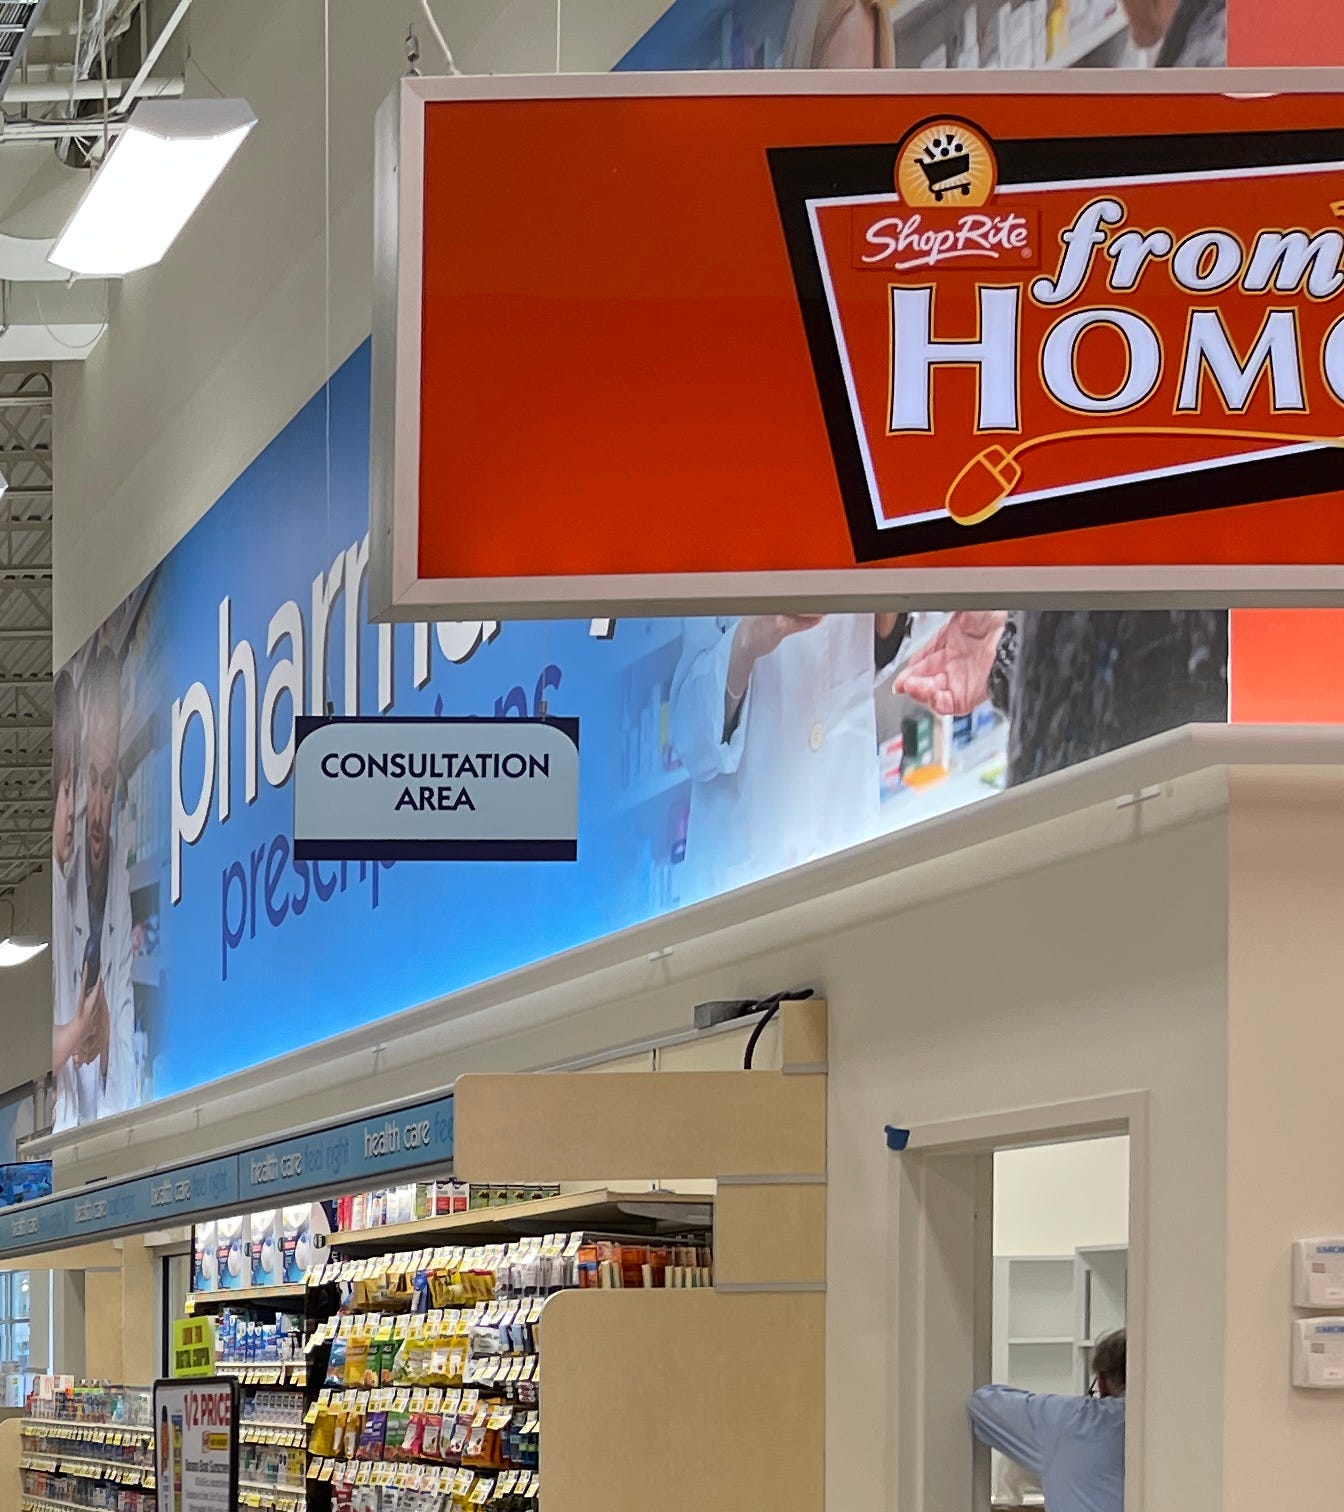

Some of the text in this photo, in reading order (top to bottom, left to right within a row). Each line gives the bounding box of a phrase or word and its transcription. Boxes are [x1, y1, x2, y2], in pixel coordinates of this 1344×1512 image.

[862, 214, 1024, 270] ShopRite
[1031, 197, 1344, 306] from
[887, 282, 1344, 436] HOM
[320, 752, 550, 779] CONSULTATION
[394, 786, 476, 811] AREA
[363, 1120, 430, 1158] health care
[249, 1151, 303, 1186] health care
[200, 1391, 231, 1427] PRICE
